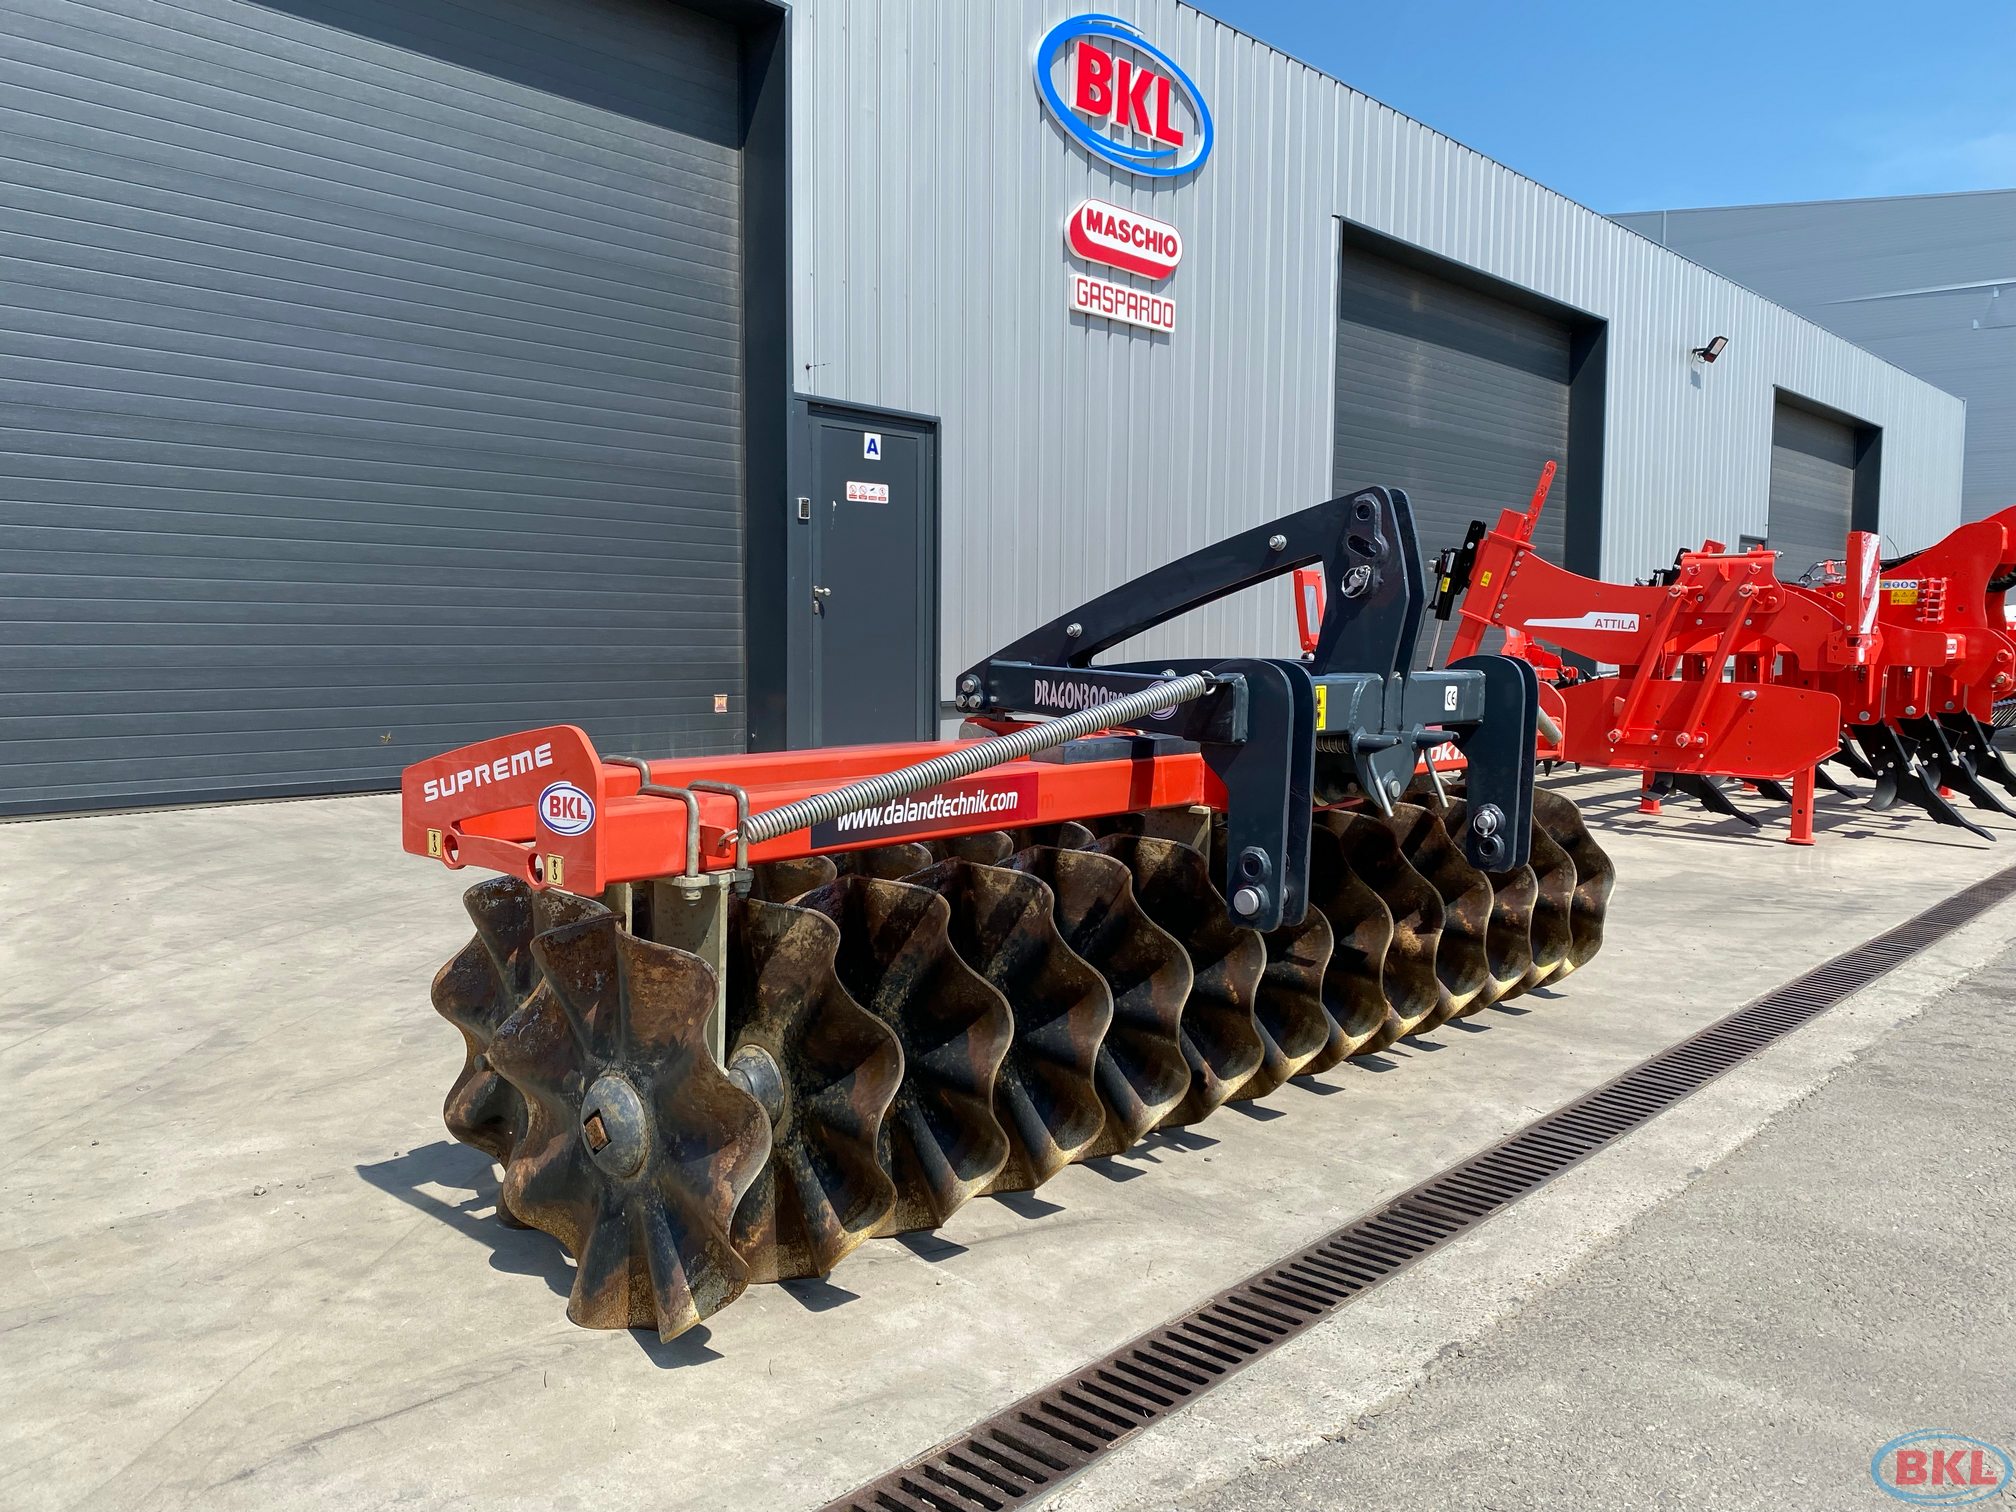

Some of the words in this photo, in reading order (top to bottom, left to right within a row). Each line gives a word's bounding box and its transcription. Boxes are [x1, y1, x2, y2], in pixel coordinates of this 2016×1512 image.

[1075, 41, 1184, 147] BKL
[1086, 207, 1178, 258] MASCHIO
[1076, 278, 1174, 329] GASPARDO
[866, 438, 879, 455] A
[1595, 618, 1636, 630] ATTILA
[423, 742, 553, 802] SUPREME
[549, 795, 588, 820] BKL
[837, 789, 1018, 832] www.dalandtechnik.com
